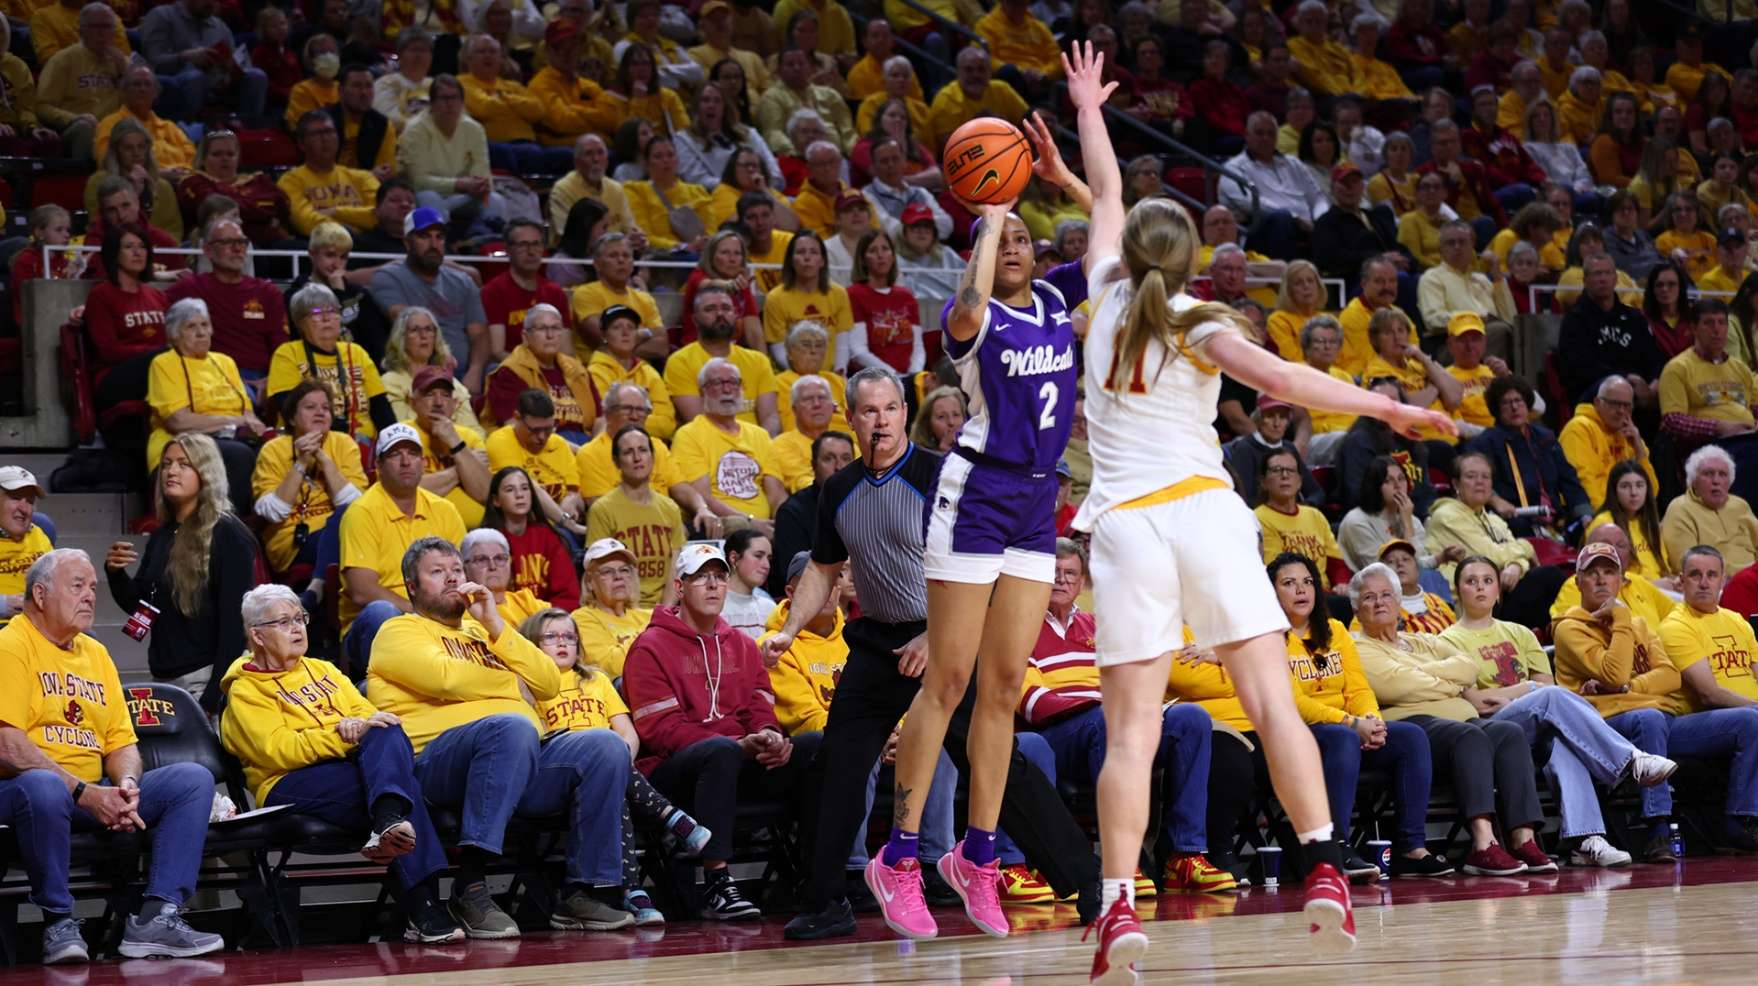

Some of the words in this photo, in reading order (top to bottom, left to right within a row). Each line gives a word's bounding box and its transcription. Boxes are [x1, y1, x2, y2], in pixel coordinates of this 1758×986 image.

[948, 143, 984, 175] ELITE
[1039, 381, 1060, 430] 2
[126, 698, 176, 717] TATE
